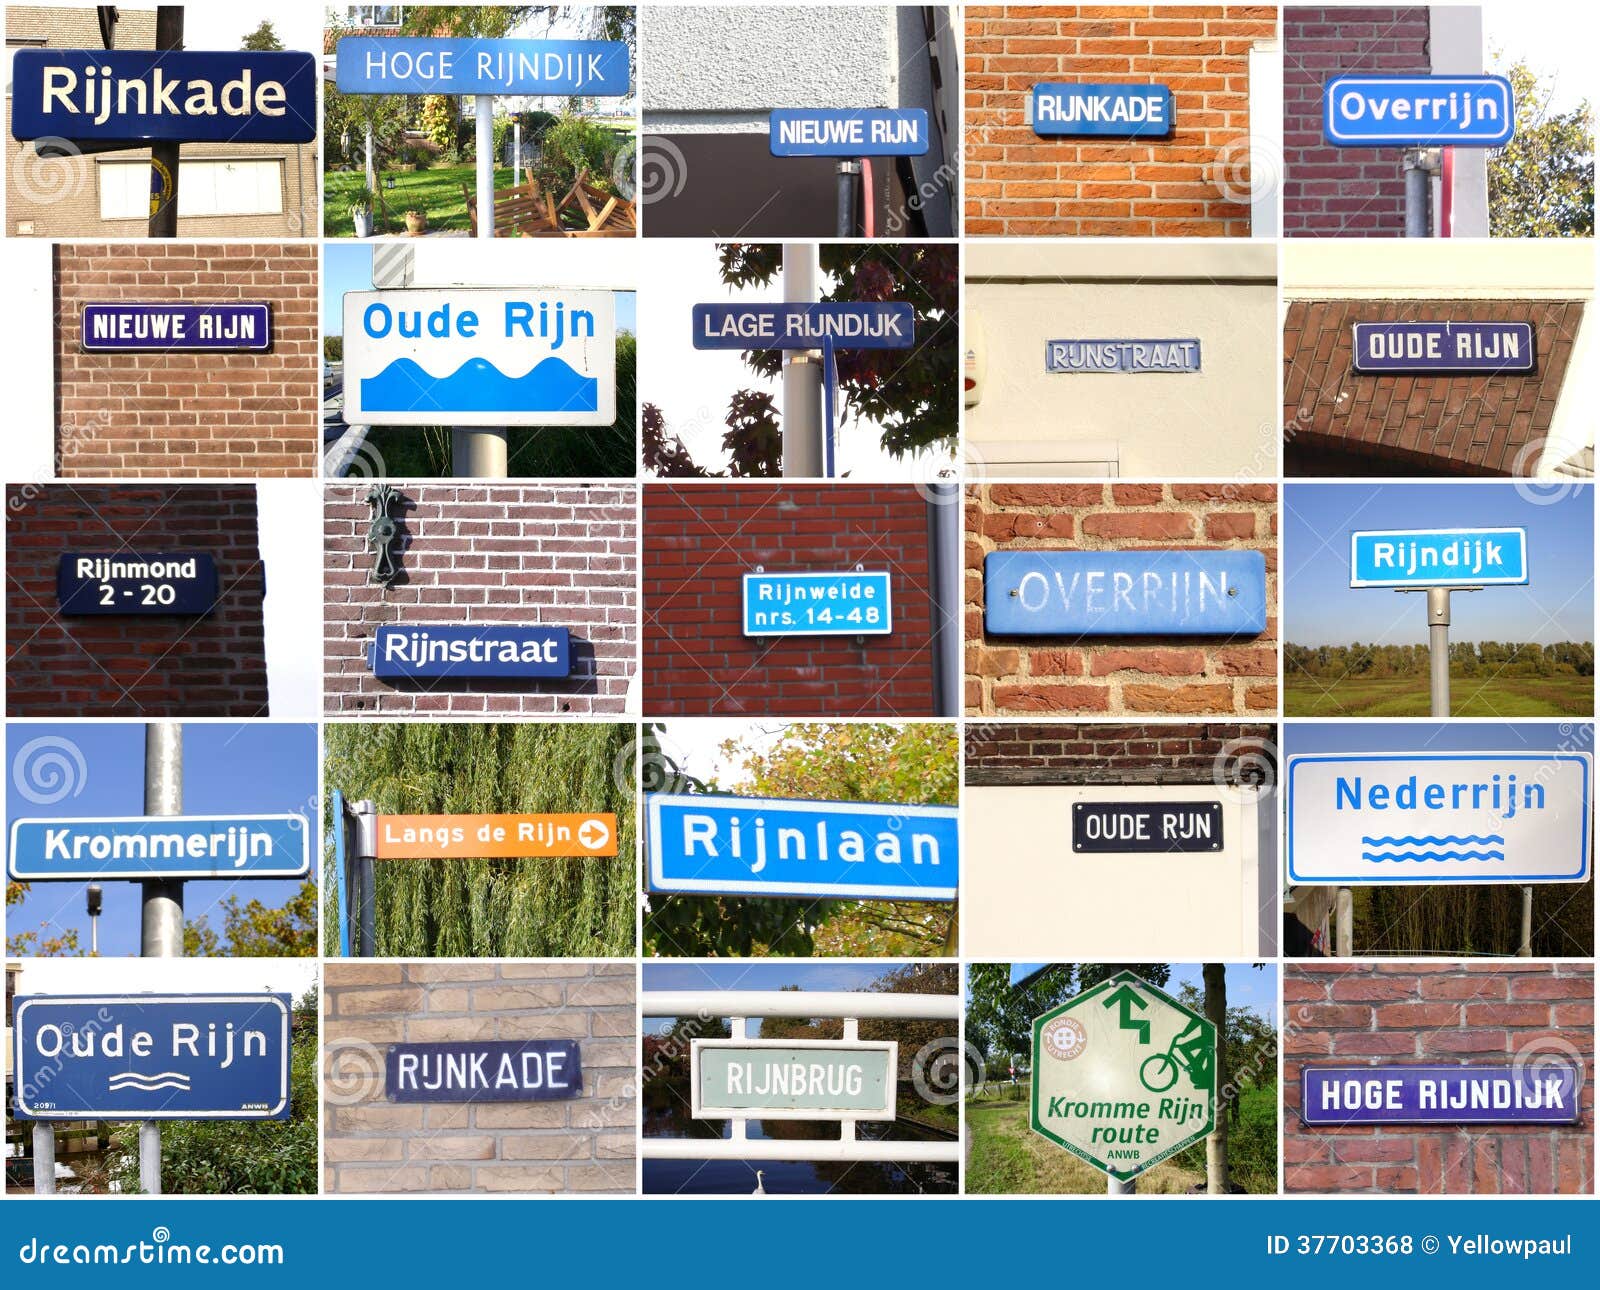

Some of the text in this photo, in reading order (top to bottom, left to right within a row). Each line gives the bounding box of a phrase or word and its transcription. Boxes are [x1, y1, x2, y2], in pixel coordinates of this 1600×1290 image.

[366, 51, 605, 87] HOGE RIJNDIJK
[42, 66, 287, 126] Rijnkade
[1037, 94, 1163, 123] RIJNKADE
[1340, 91, 1498, 130] Overrijn
[779, 119, 918, 146] NIEUWE RIJN
[93, 313, 256, 341] NIEUWE RIJN
[363, 301, 595, 350] Oude Rijn
[705, 313, 903, 338] LAGE RIJNDIJK
[1369, 332, 1520, 360] OUDE RIJN
[76, 557, 197, 587] Rijnmond
[1373, 540, 1504, 575] Rijndijk
[99, 584, 115, 606] 2
[141, 584, 176, 606] 20
[758, 582, 876, 606] Rijnweide
[1018, 571, 1228, 626] OVERRIJN
[755, 608, 881, 627] nrs. 14-48
[384, 633, 559, 669] Rijnstraat
[1336, 774, 1546, 820] Nederrijn
[384, 823, 571, 848] Langs de Rijn
[1086, 813, 1211, 840] OUDE RIJN
[45, 827, 273, 868] Krommerijn
[683, 814, 941, 873] Rijnlaan
[36, 1022, 267, 1069] Oude Rijn
[398, 1051, 569, 1090] RIJNKADE
[727, 1062, 862, 1097] RIJNBRUG
[1321, 1079, 1564, 1110] HOGE RIJNDIJK
[1047, 1096, 1204, 1125] Kromme Rijn
[1091, 1123, 1160, 1144] route
[1107, 1149, 1140, 1159] ANWB
